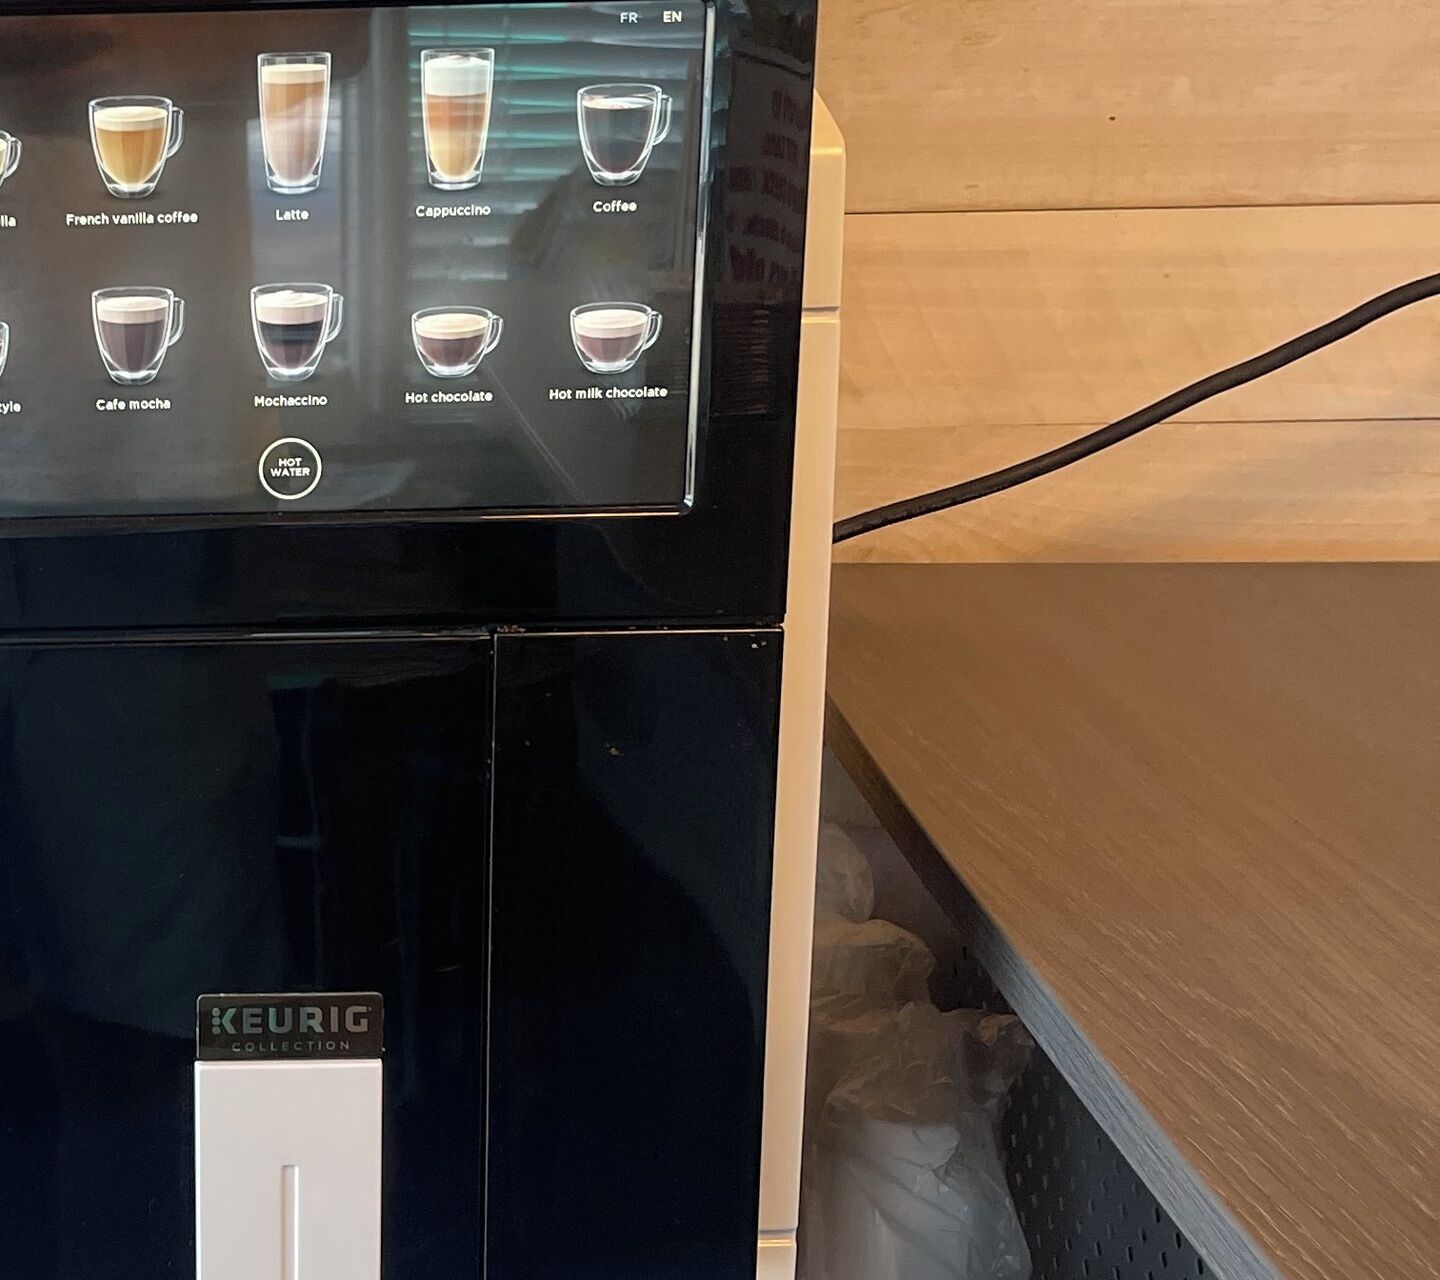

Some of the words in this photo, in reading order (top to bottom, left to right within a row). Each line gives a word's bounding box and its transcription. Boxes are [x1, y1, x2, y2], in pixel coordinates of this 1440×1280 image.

[620, 11, 639, 24] FR
[663, 10, 682, 23] EN
[415, 204, 491, 219] Cappuccino
[592, 200, 637, 213] Coffee
[66, 213, 109, 226] French
[112, 212, 154, 225] vanilla
[157, 211, 199, 224] coffee
[275, 208, 309, 221] Latte
[405, 391, 428, 404] Hot
[430, 390, 494, 402] chocolate
[549, 388, 572, 400] Hot
[575, 387, 603, 399] milk
[605, 386, 668, 398] chocolate
[95, 398, 126, 411] Cafe
[129, 398, 171, 410] mocha
[254, 394, 328, 407] Mochaccino
[278, 457, 302, 467] HOT
[270, 467, 310, 477] WATER
[211, 1005, 370, 1035] KEURIG
[231, 1040, 351, 1052] COLLECTION
